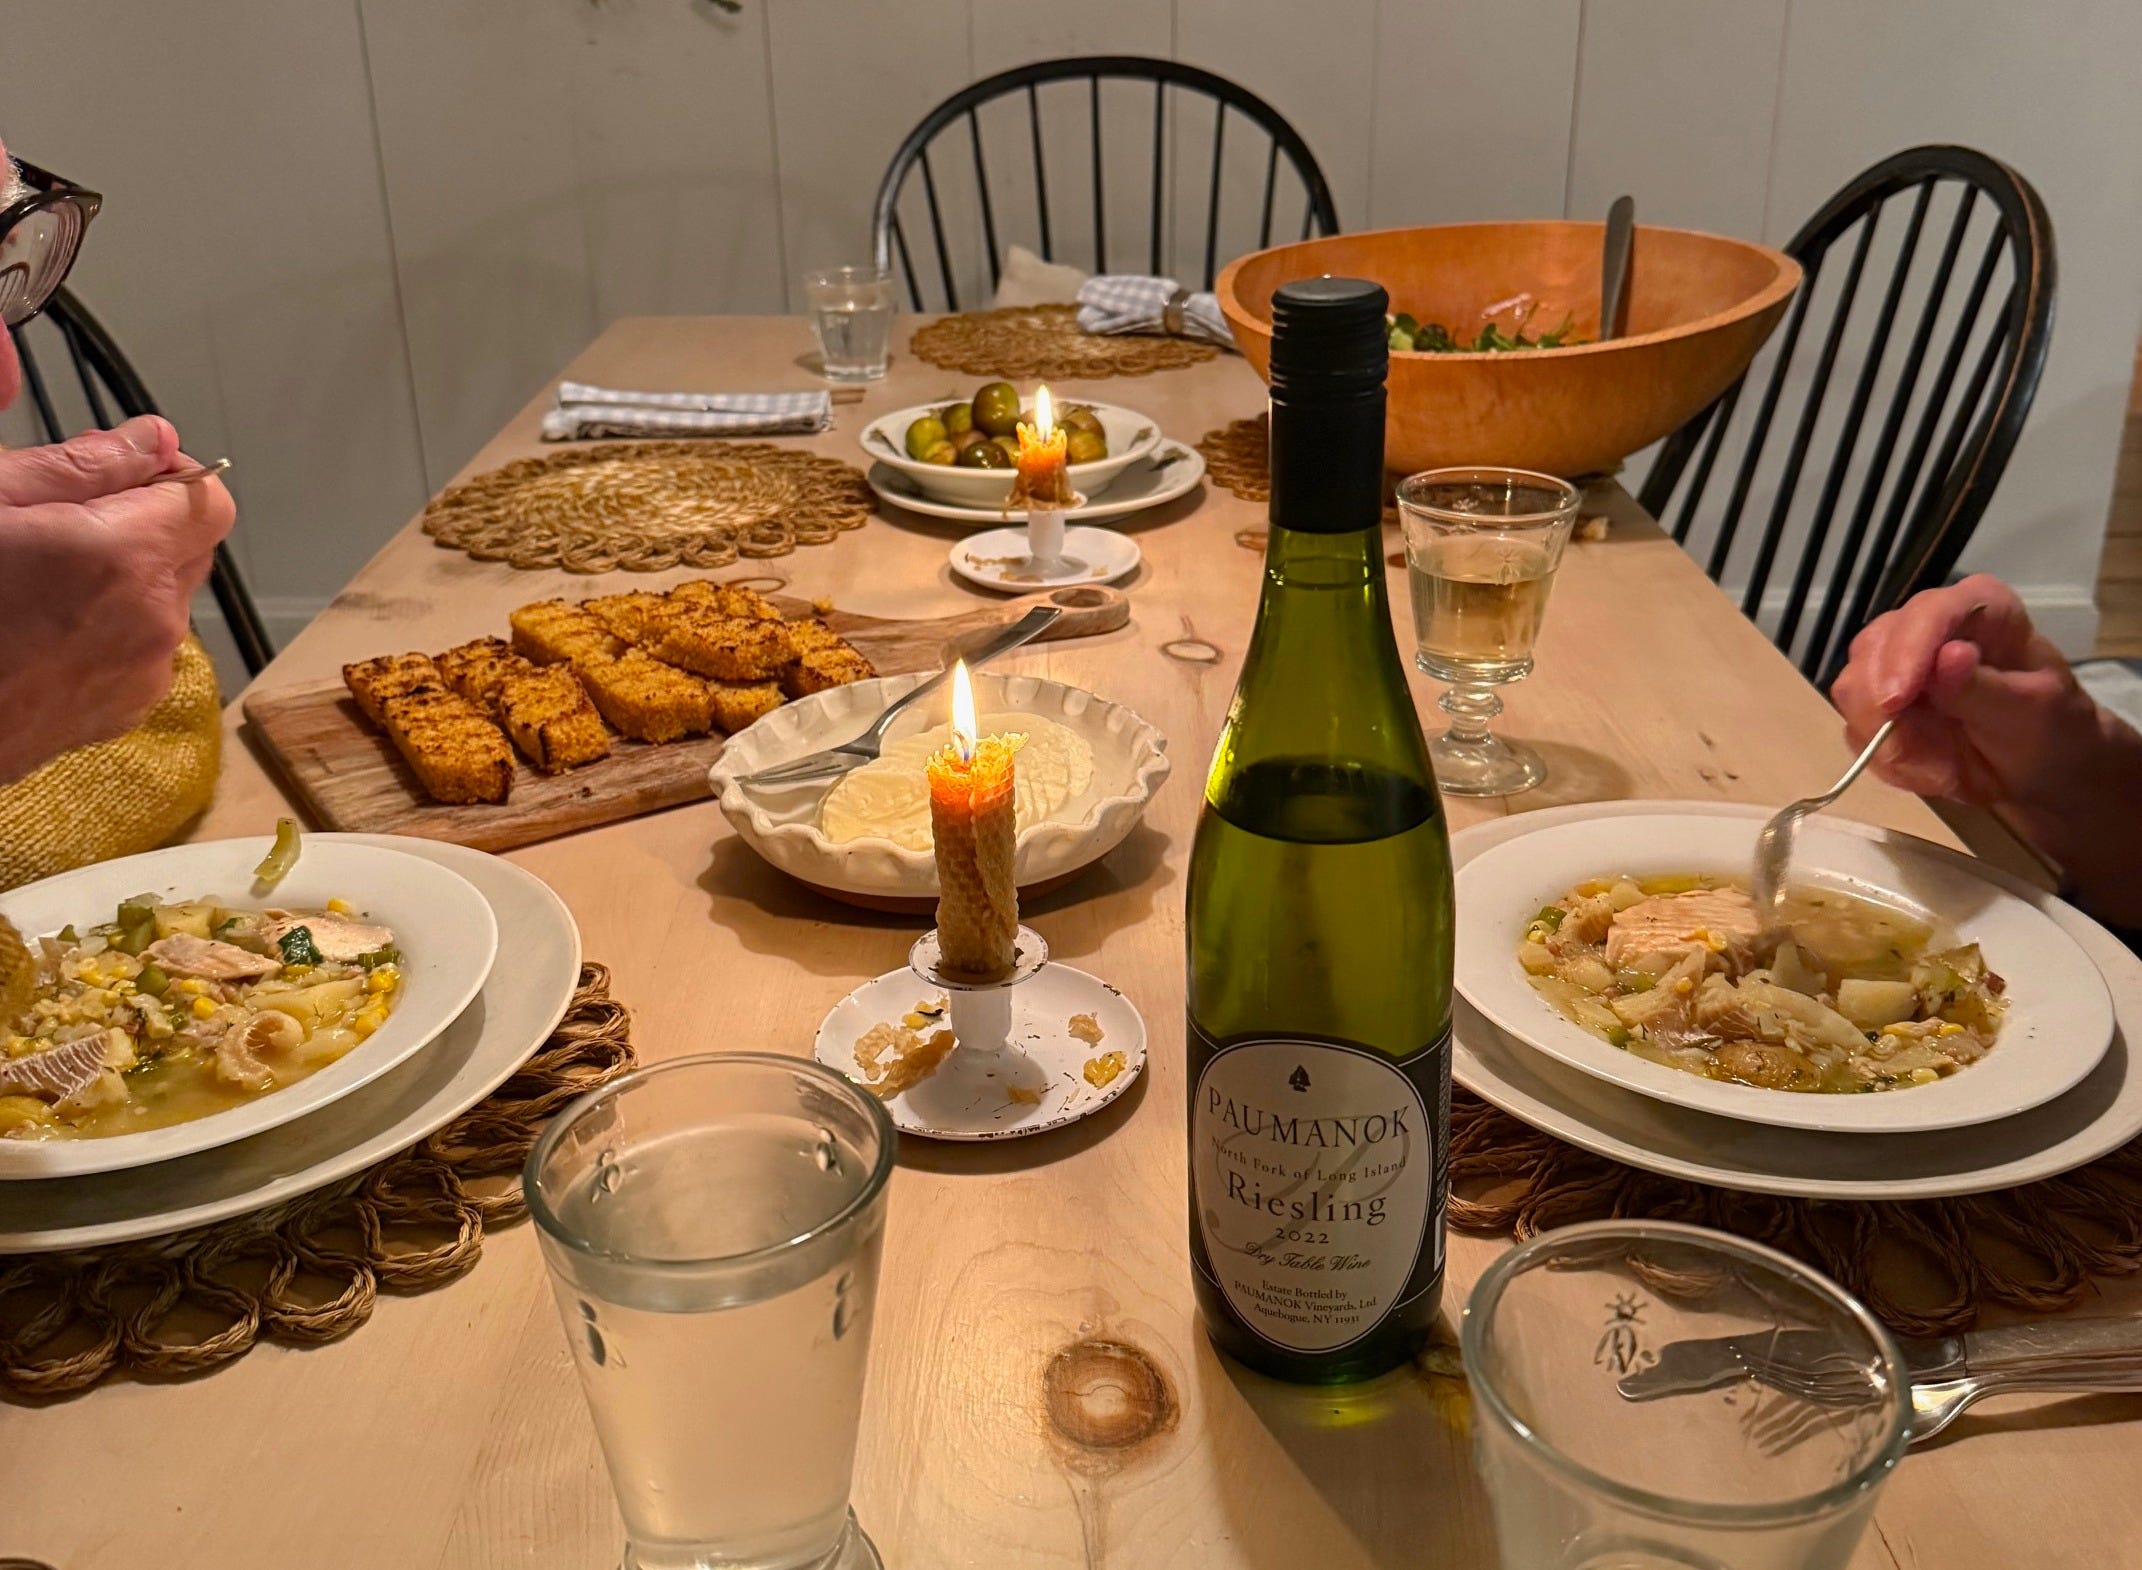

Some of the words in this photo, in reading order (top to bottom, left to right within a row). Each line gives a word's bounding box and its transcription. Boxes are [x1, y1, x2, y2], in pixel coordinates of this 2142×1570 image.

[1208, 1086, 1409, 1147] PAUMANOK
[1211, 1136, 1247, 1165] North
[1253, 1158, 1286, 1177] Fork
[1293, 1170, 1310, 1180] of
[1317, 1169, 1357, 1183] Long
[1364, 1155, 1407, 1178] Island
[1228, 1169, 1387, 1226] Riesling
[1275, 1227, 1329, 1244] 2022
[1245, 1242, 1276, 1265] Dry
[1278, 1253, 1325, 1271] Table
[1330, 1254, 1371, 1271] Wine
[1234, 1280, 1301, 1311] PAUMANOK
[1262, 1280, 1293, 1297] Estate
[1295, 1287, 1333, 1300] Bottled
[1335, 1290, 1348, 1301] by
[1253, 1303, 1311, 1324] Aquebogue,
[1313, 1315, 1332, 1324] NY
[1335, 1315, 1360, 1325] 11931
